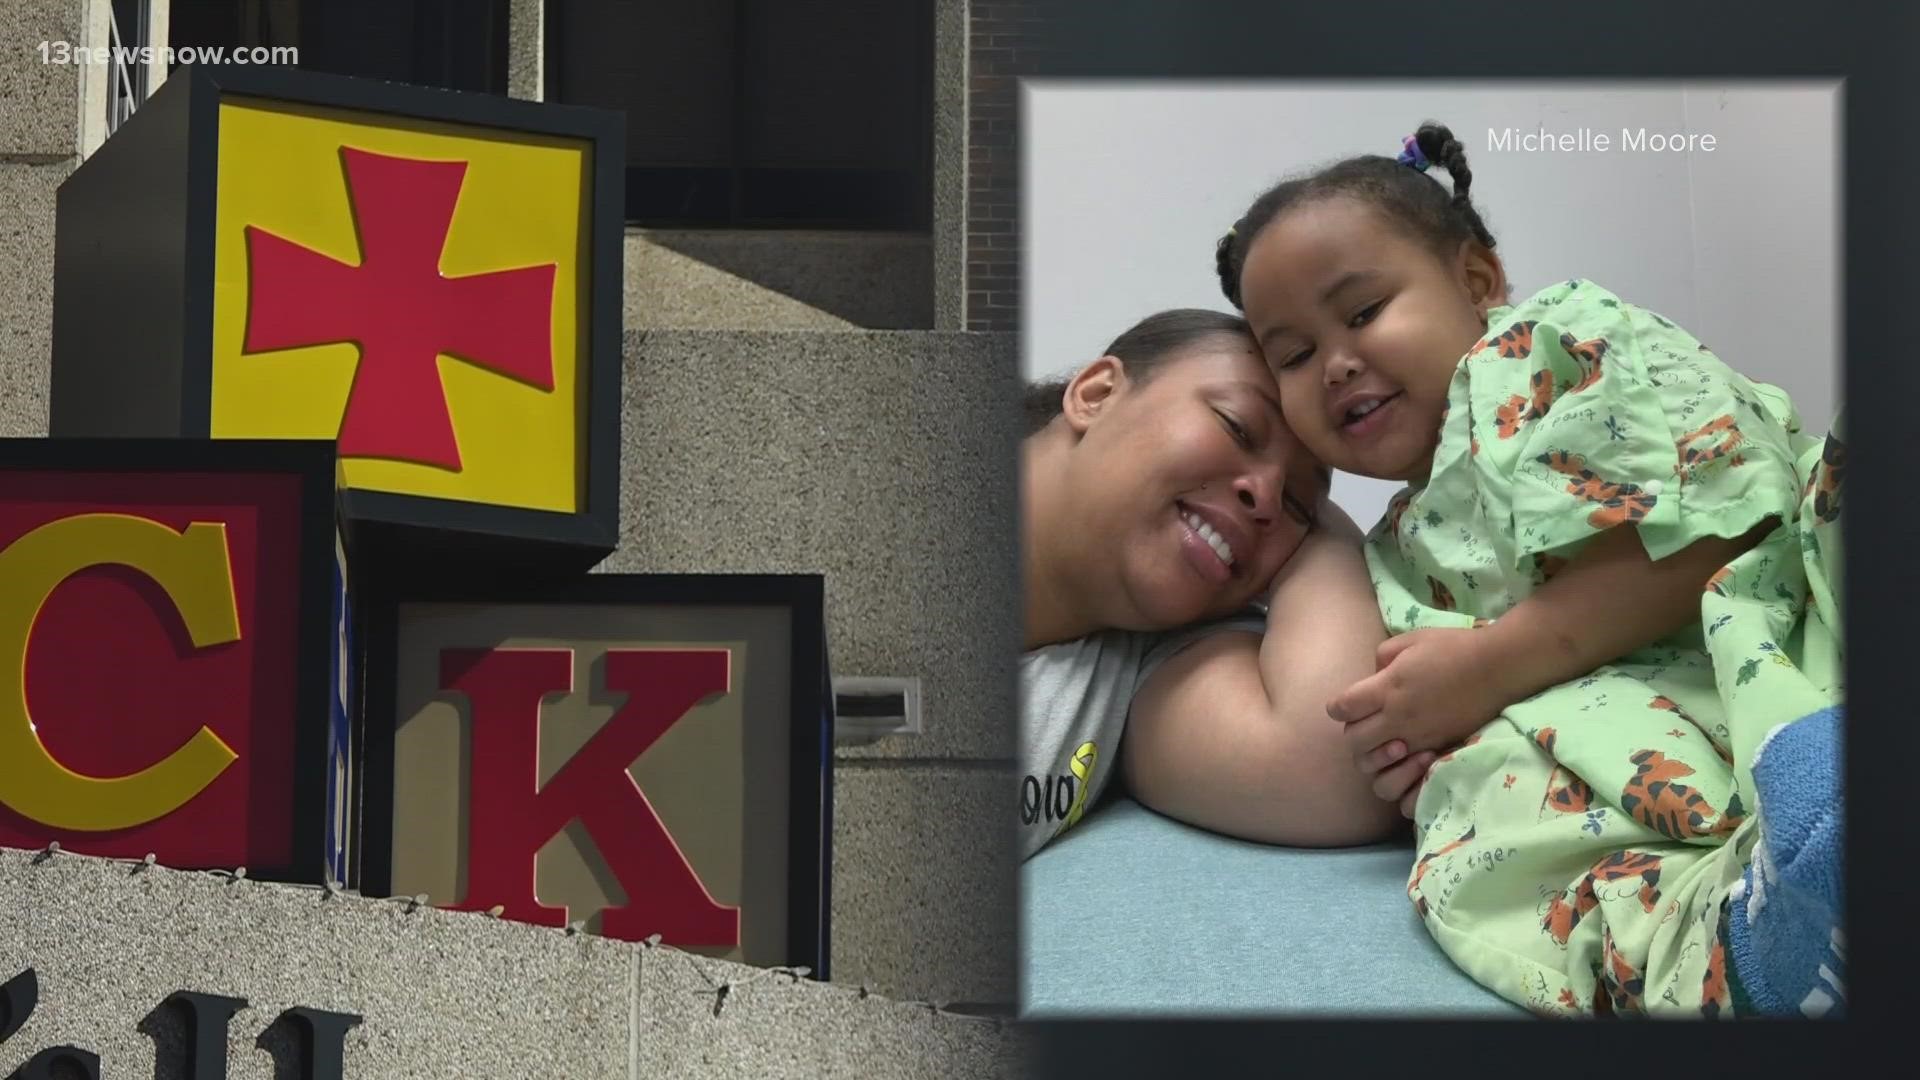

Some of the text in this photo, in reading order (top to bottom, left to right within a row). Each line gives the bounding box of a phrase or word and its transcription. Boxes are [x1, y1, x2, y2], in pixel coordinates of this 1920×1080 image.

[0, 512, 241, 831] C
[438, 647, 741, 946] K
[1466, 848, 1518, 872] tiger
